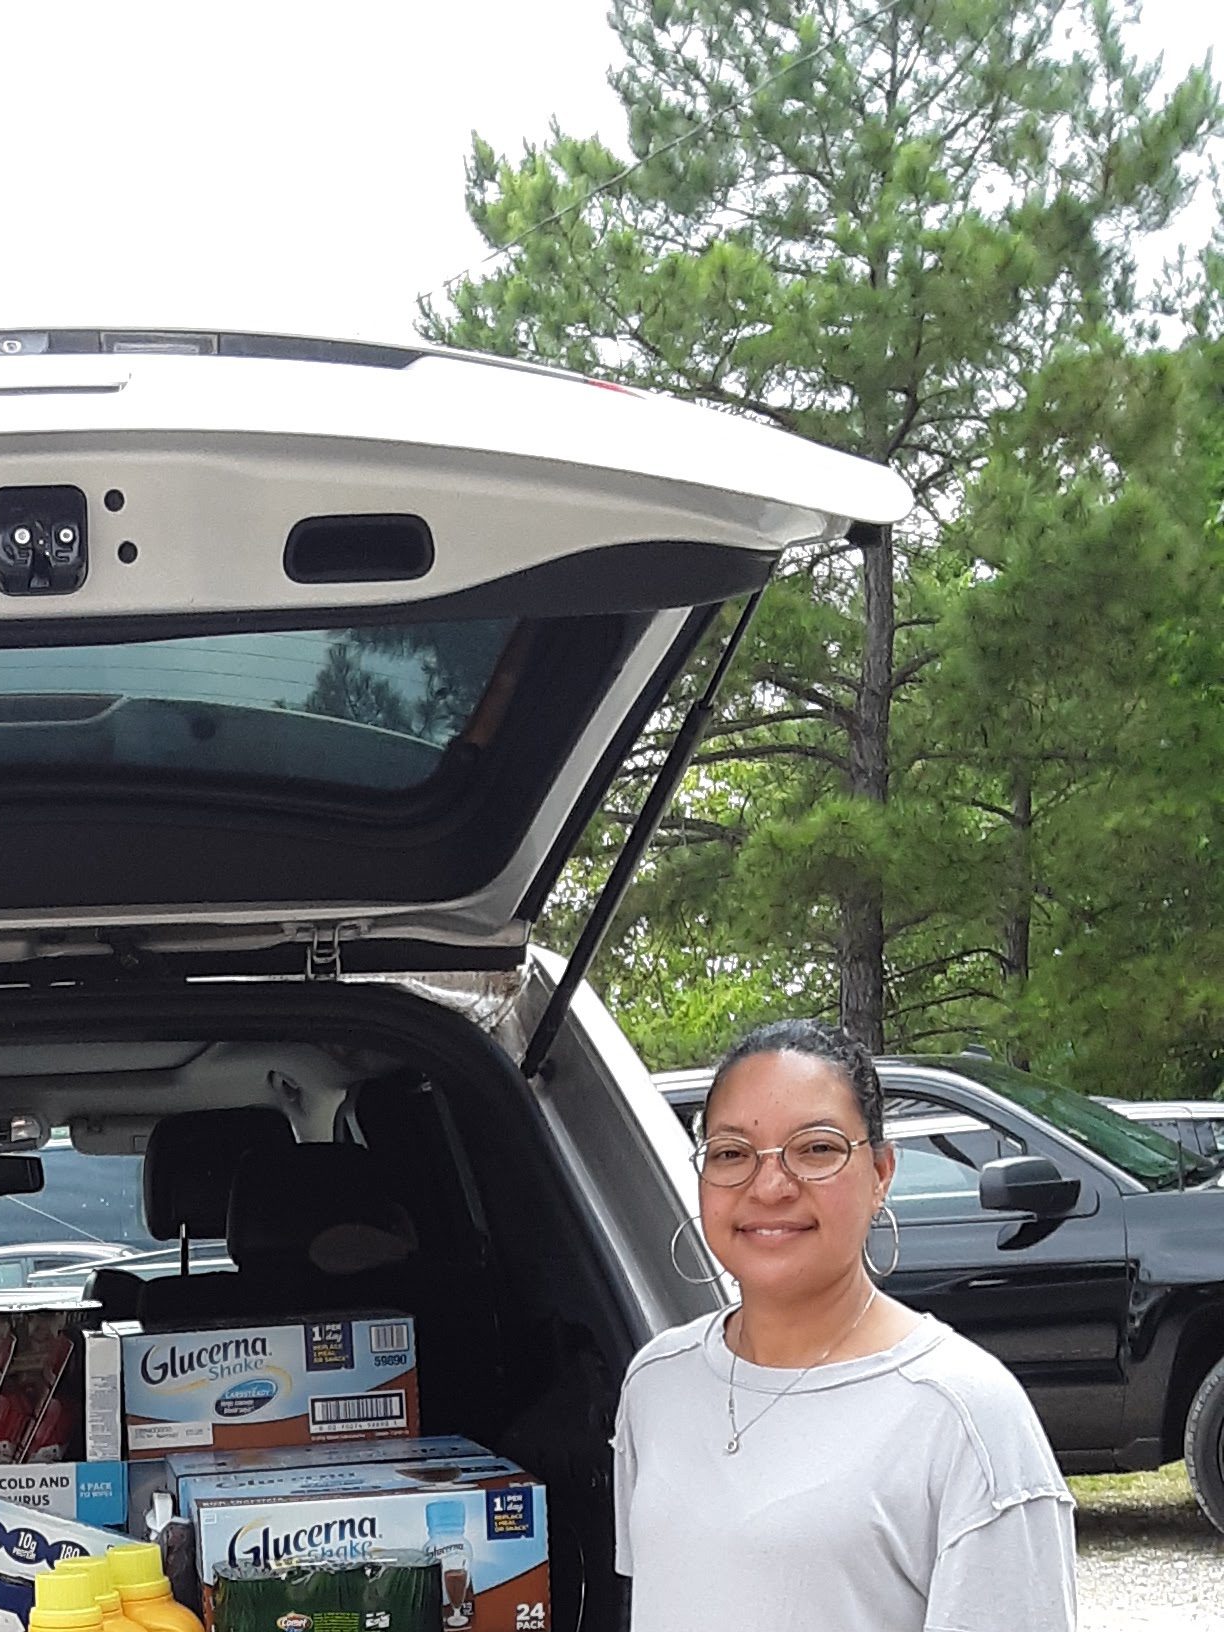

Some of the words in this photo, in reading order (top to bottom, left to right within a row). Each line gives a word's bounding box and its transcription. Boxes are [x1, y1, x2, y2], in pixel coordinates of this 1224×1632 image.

[312, 1326, 322, 1342] 1
[141, 1336, 268, 1386] Glucerna
[208, 1358, 264, 1381] Shake
[39, 1476, 70, 1488] AND
[494, 1497, 504, 1512] 1
[507, 1502, 523, 1513] day
[18, 1531, 37, 1550] 10g
[228, 1516, 378, 1568] Glucerna
[12, 1547, 37, 1561] PROTEIN
[516, 1603, 545, 1620] 24
[516, 1620, 545, 1630] PACK
